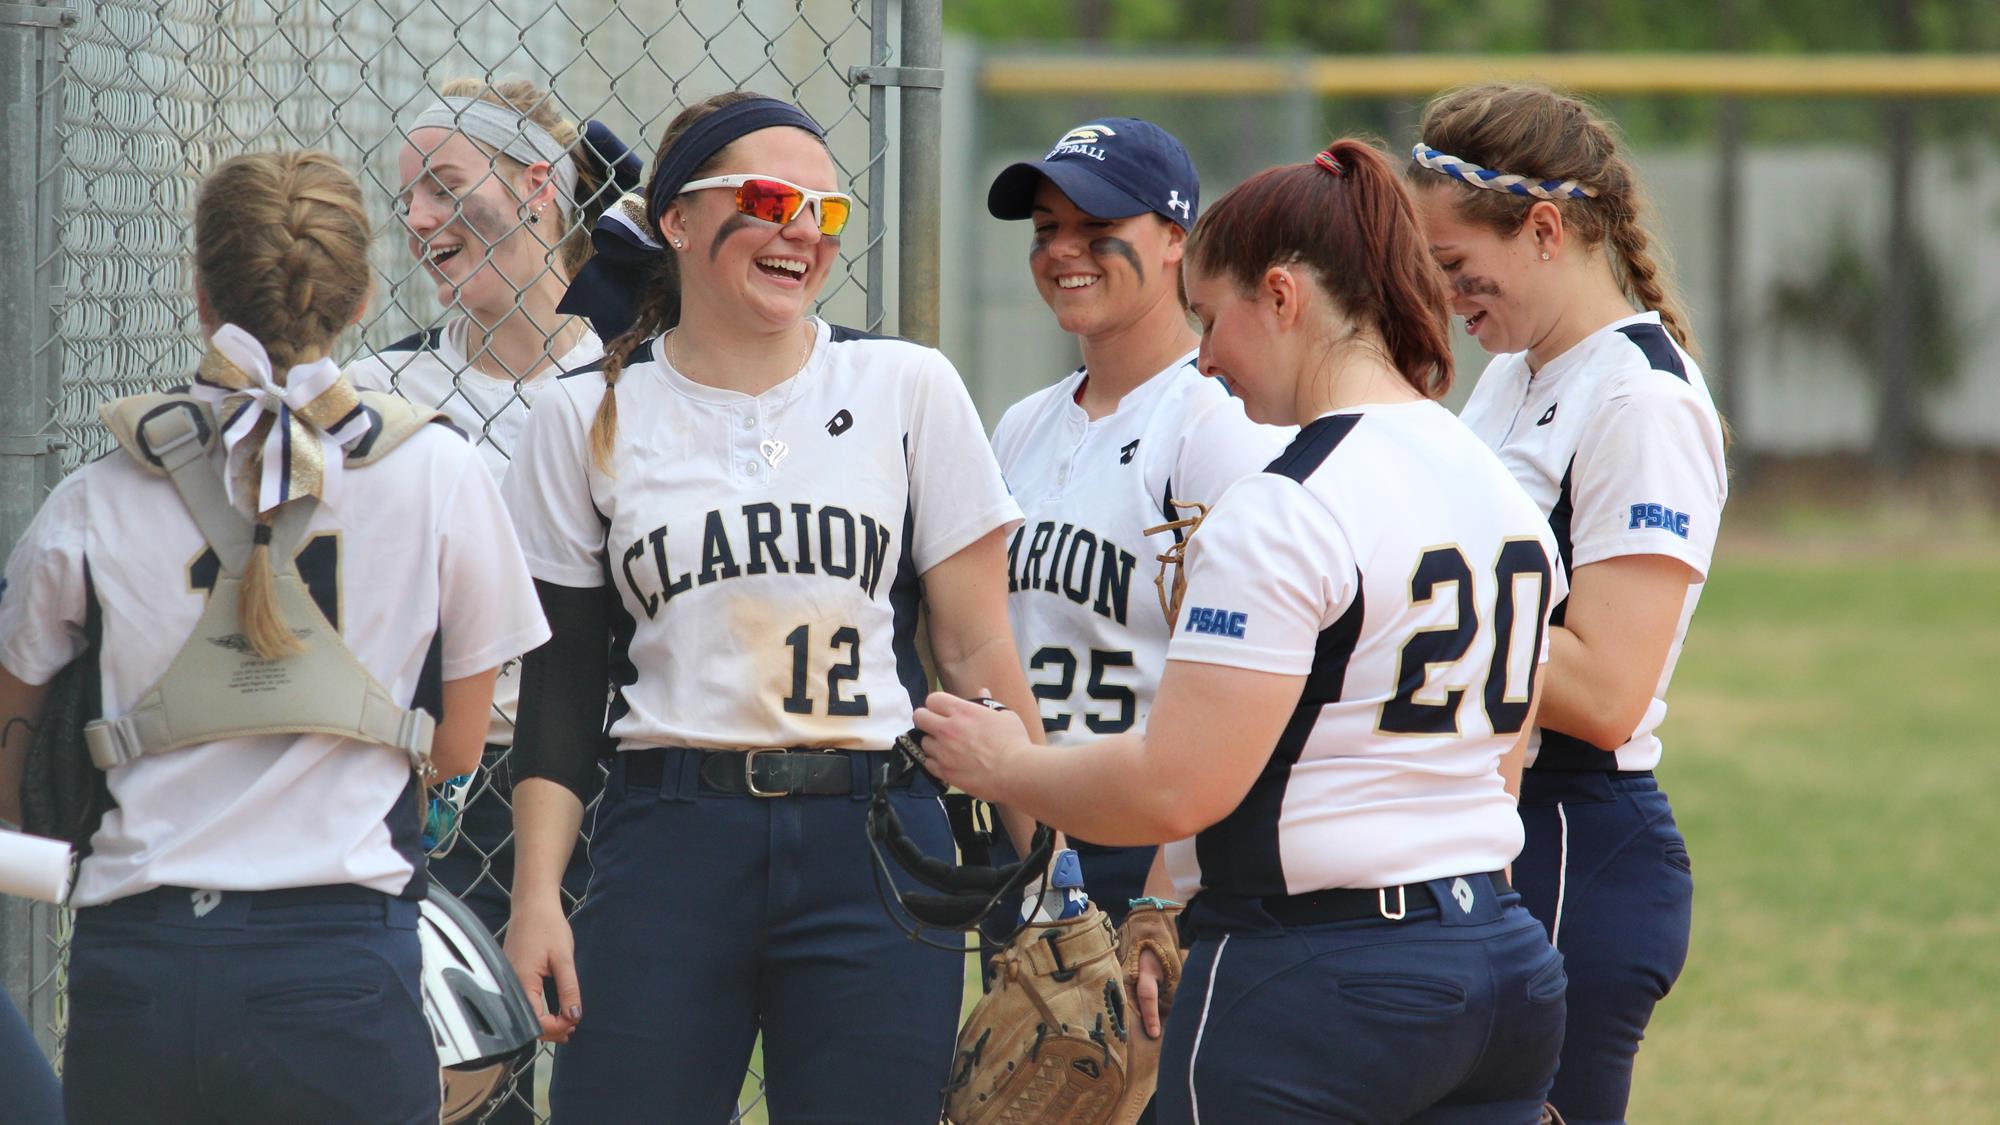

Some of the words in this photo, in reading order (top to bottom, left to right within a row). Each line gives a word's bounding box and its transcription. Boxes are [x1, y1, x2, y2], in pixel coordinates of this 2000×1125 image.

[622, 502, 890, 620] CLARION
[1628, 503, 1690, 540] PSAC
[1184, 606, 1248, 640] PSAC
[1372, 534, 1552, 737] 20
[783, 624, 869, 717] 12
[1030, 647, 1136, 735] 25
